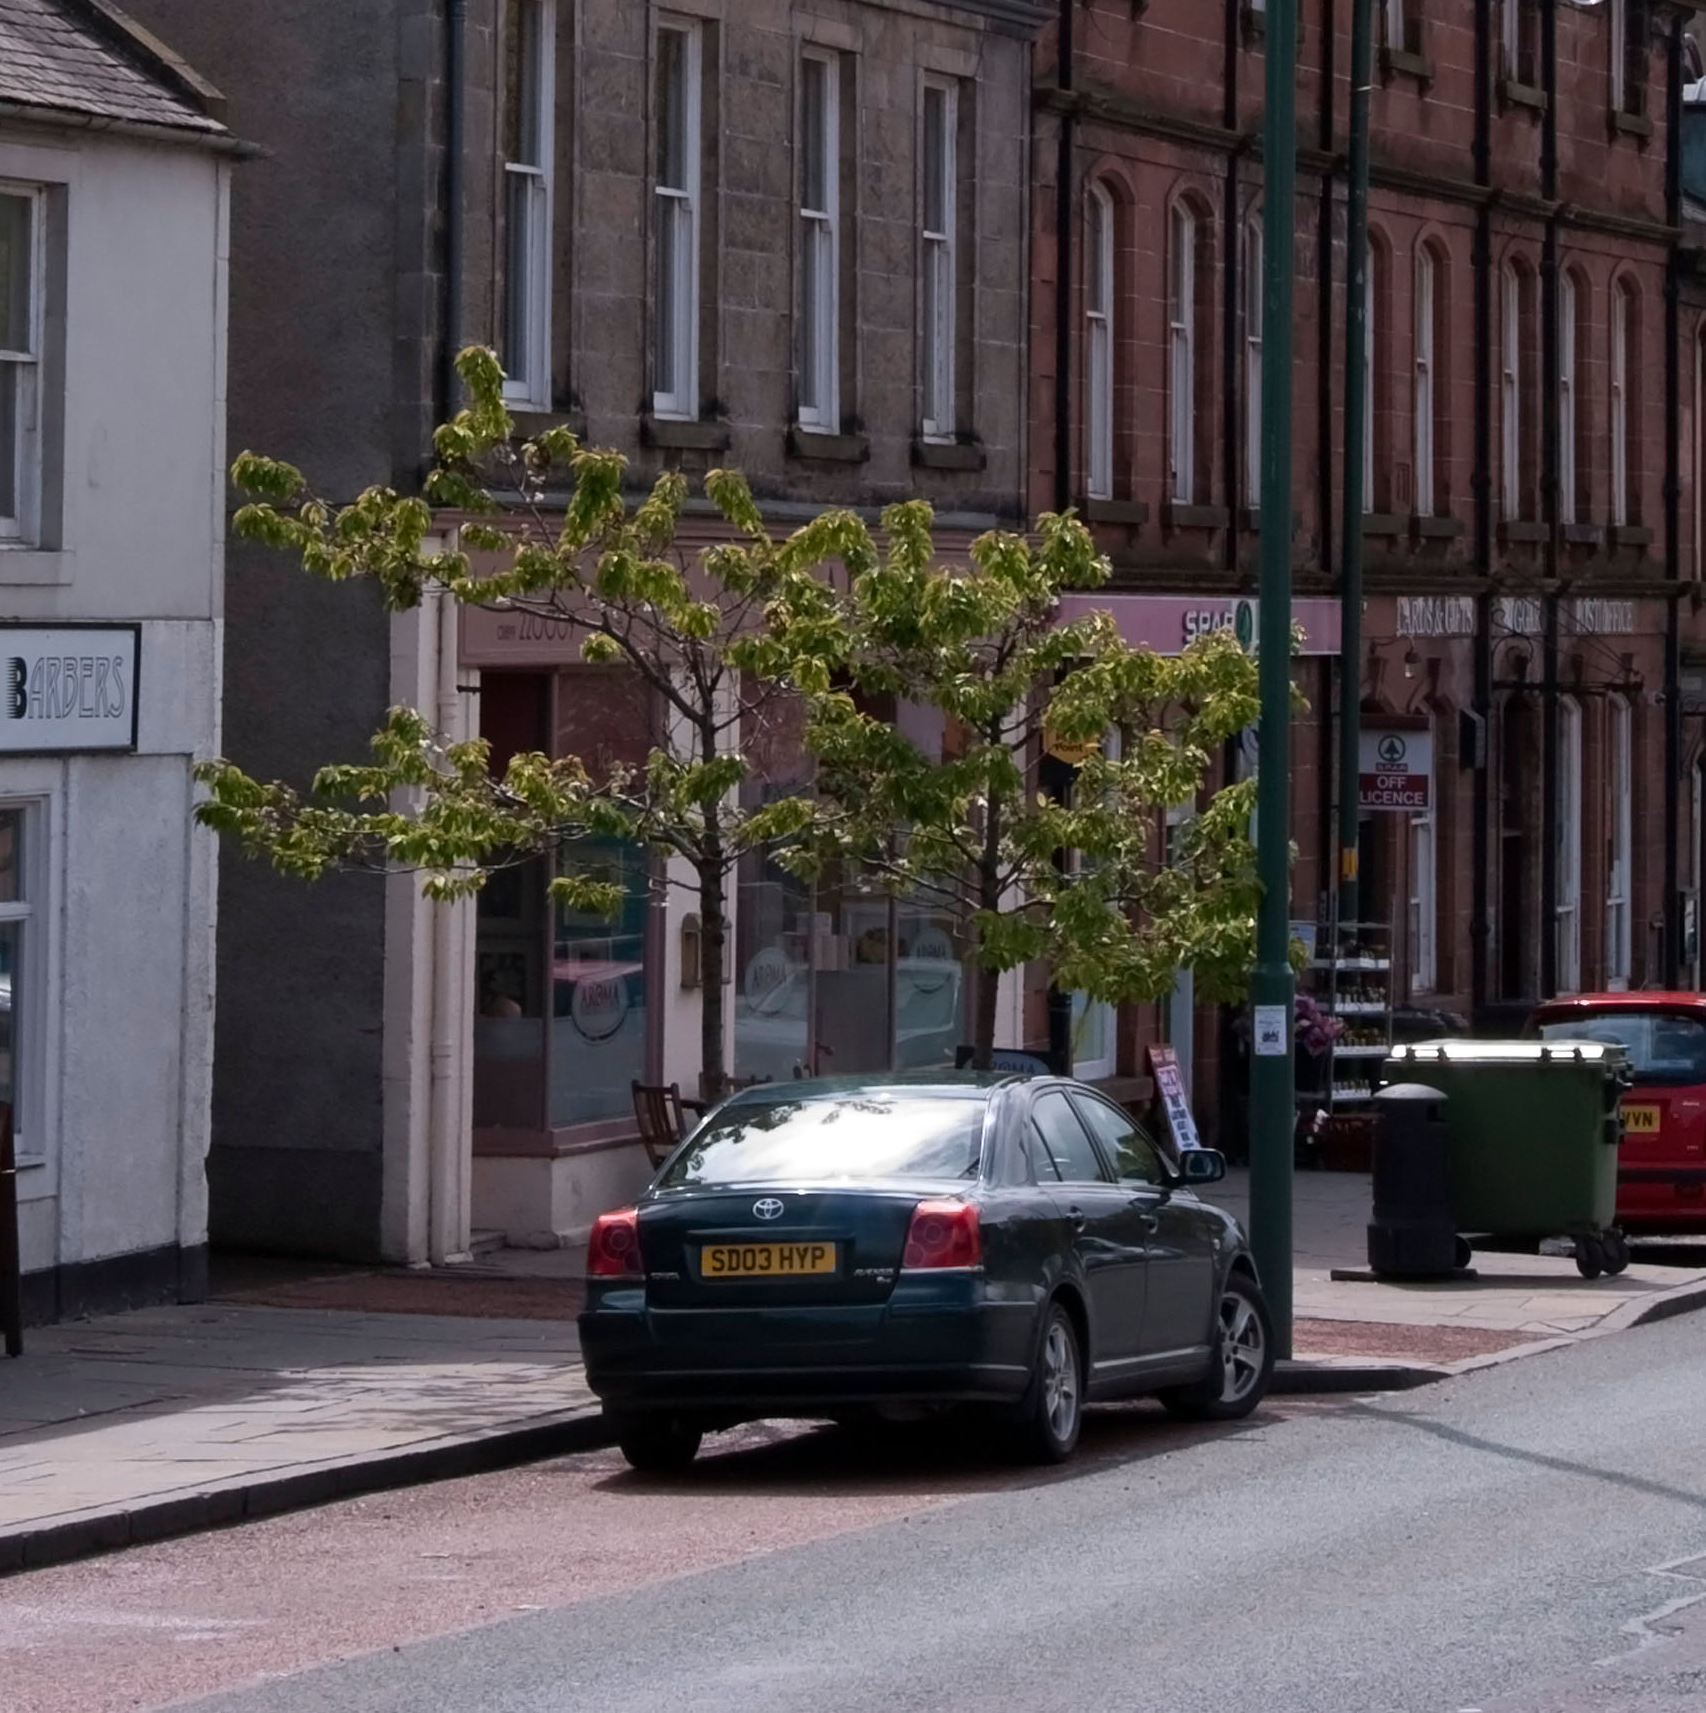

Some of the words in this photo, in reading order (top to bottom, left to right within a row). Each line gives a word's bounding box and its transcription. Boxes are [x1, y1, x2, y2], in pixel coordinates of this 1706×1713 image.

[6, 654, 126, 720] BARBERS
[1377, 775, 1406, 789] OFF
[1359, 791, 1424, 805] LICENCE
[581, 981, 620, 1008] AROMA
[713, 1246, 773, 1273] SD03
[779, 1245, 826, 1271] HYP
